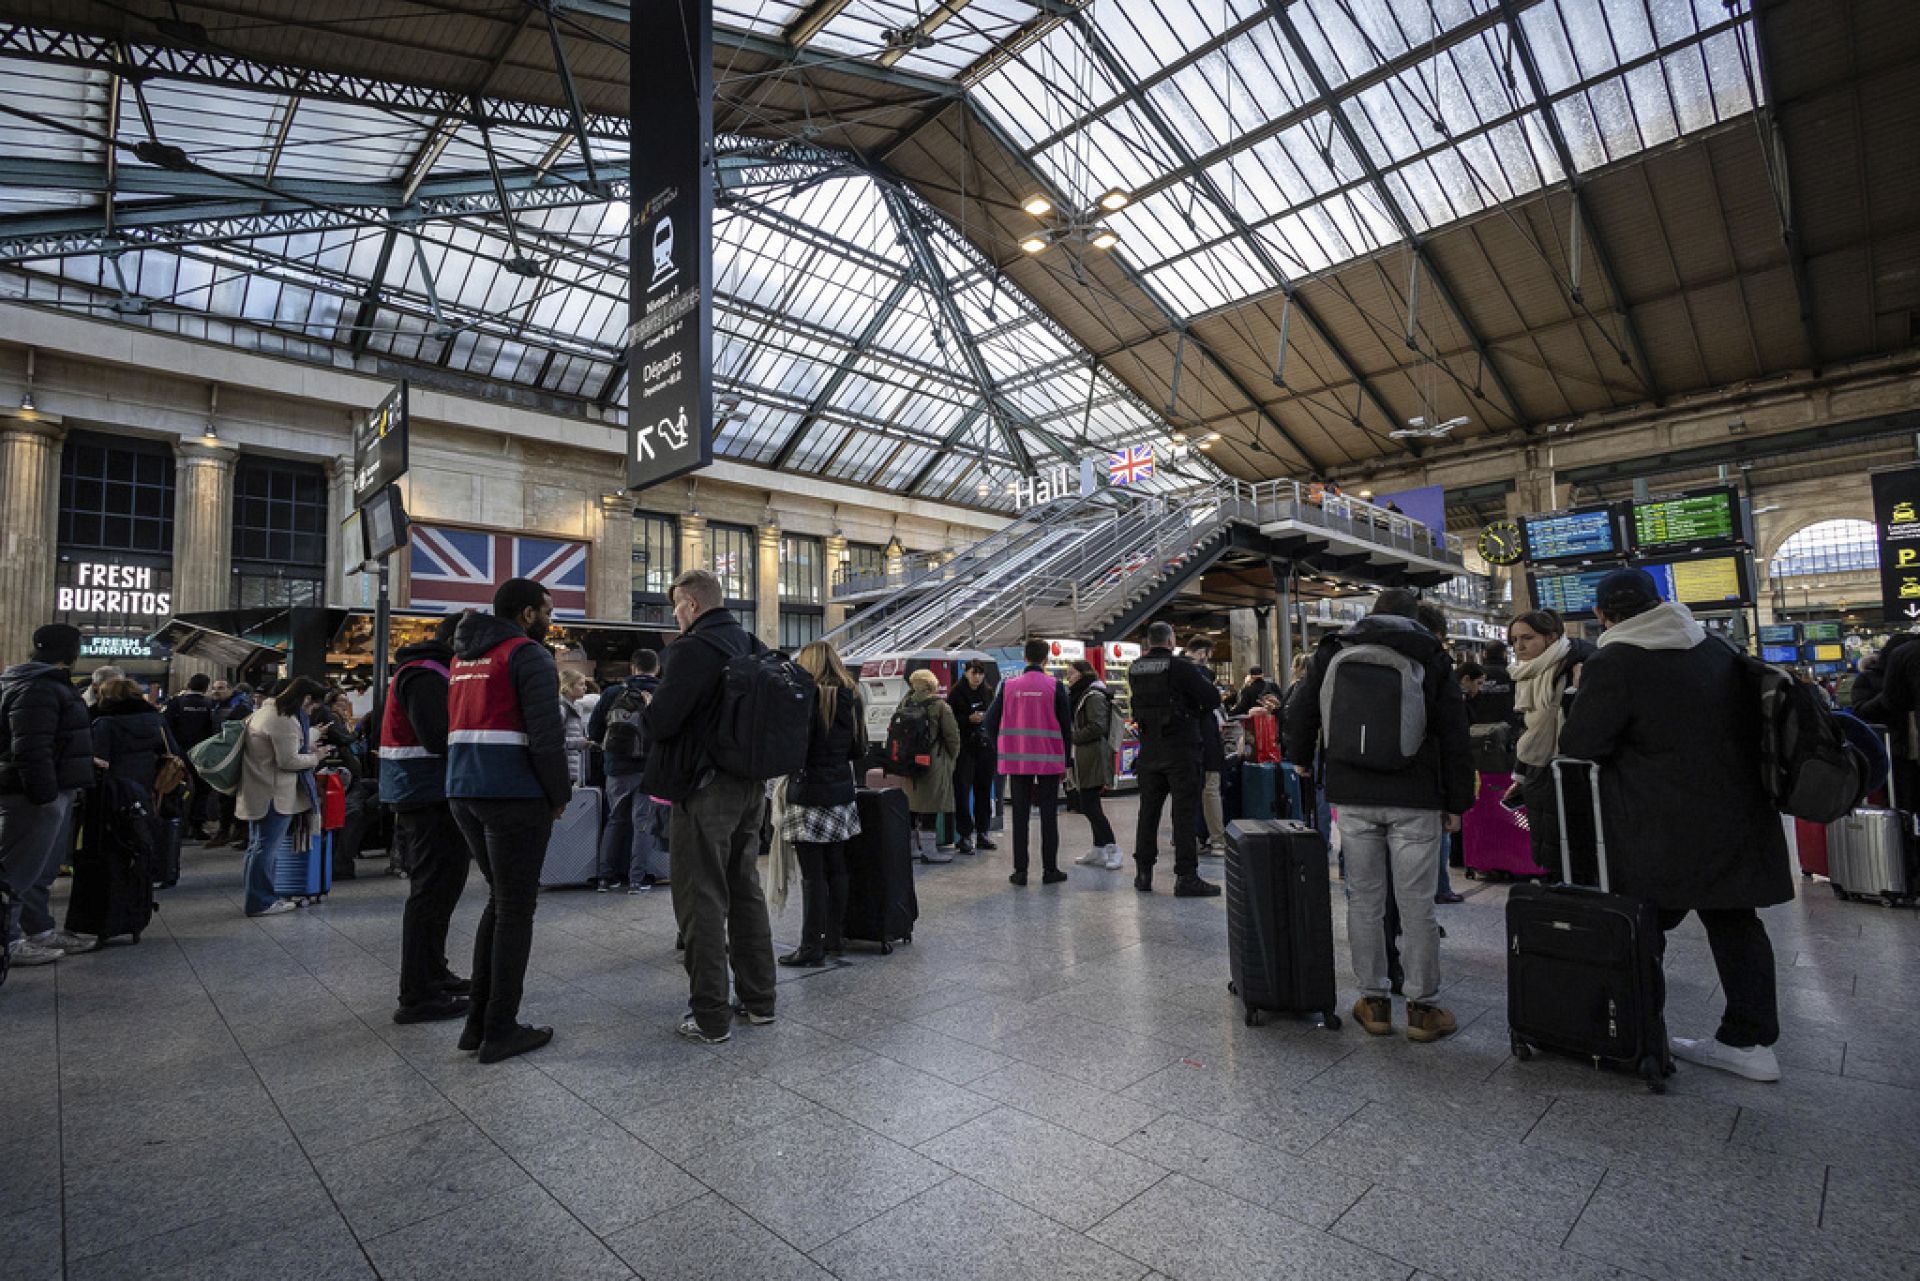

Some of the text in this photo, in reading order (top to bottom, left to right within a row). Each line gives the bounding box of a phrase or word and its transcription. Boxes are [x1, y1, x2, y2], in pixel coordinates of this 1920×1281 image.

[643, 352, 681, 383] Départs
[1015, 467, 1070, 509] Hall
[1898, 548, 1917, 566] P
[79, 562, 151, 590] FRESH
[92, 637, 140, 647] FRESH
